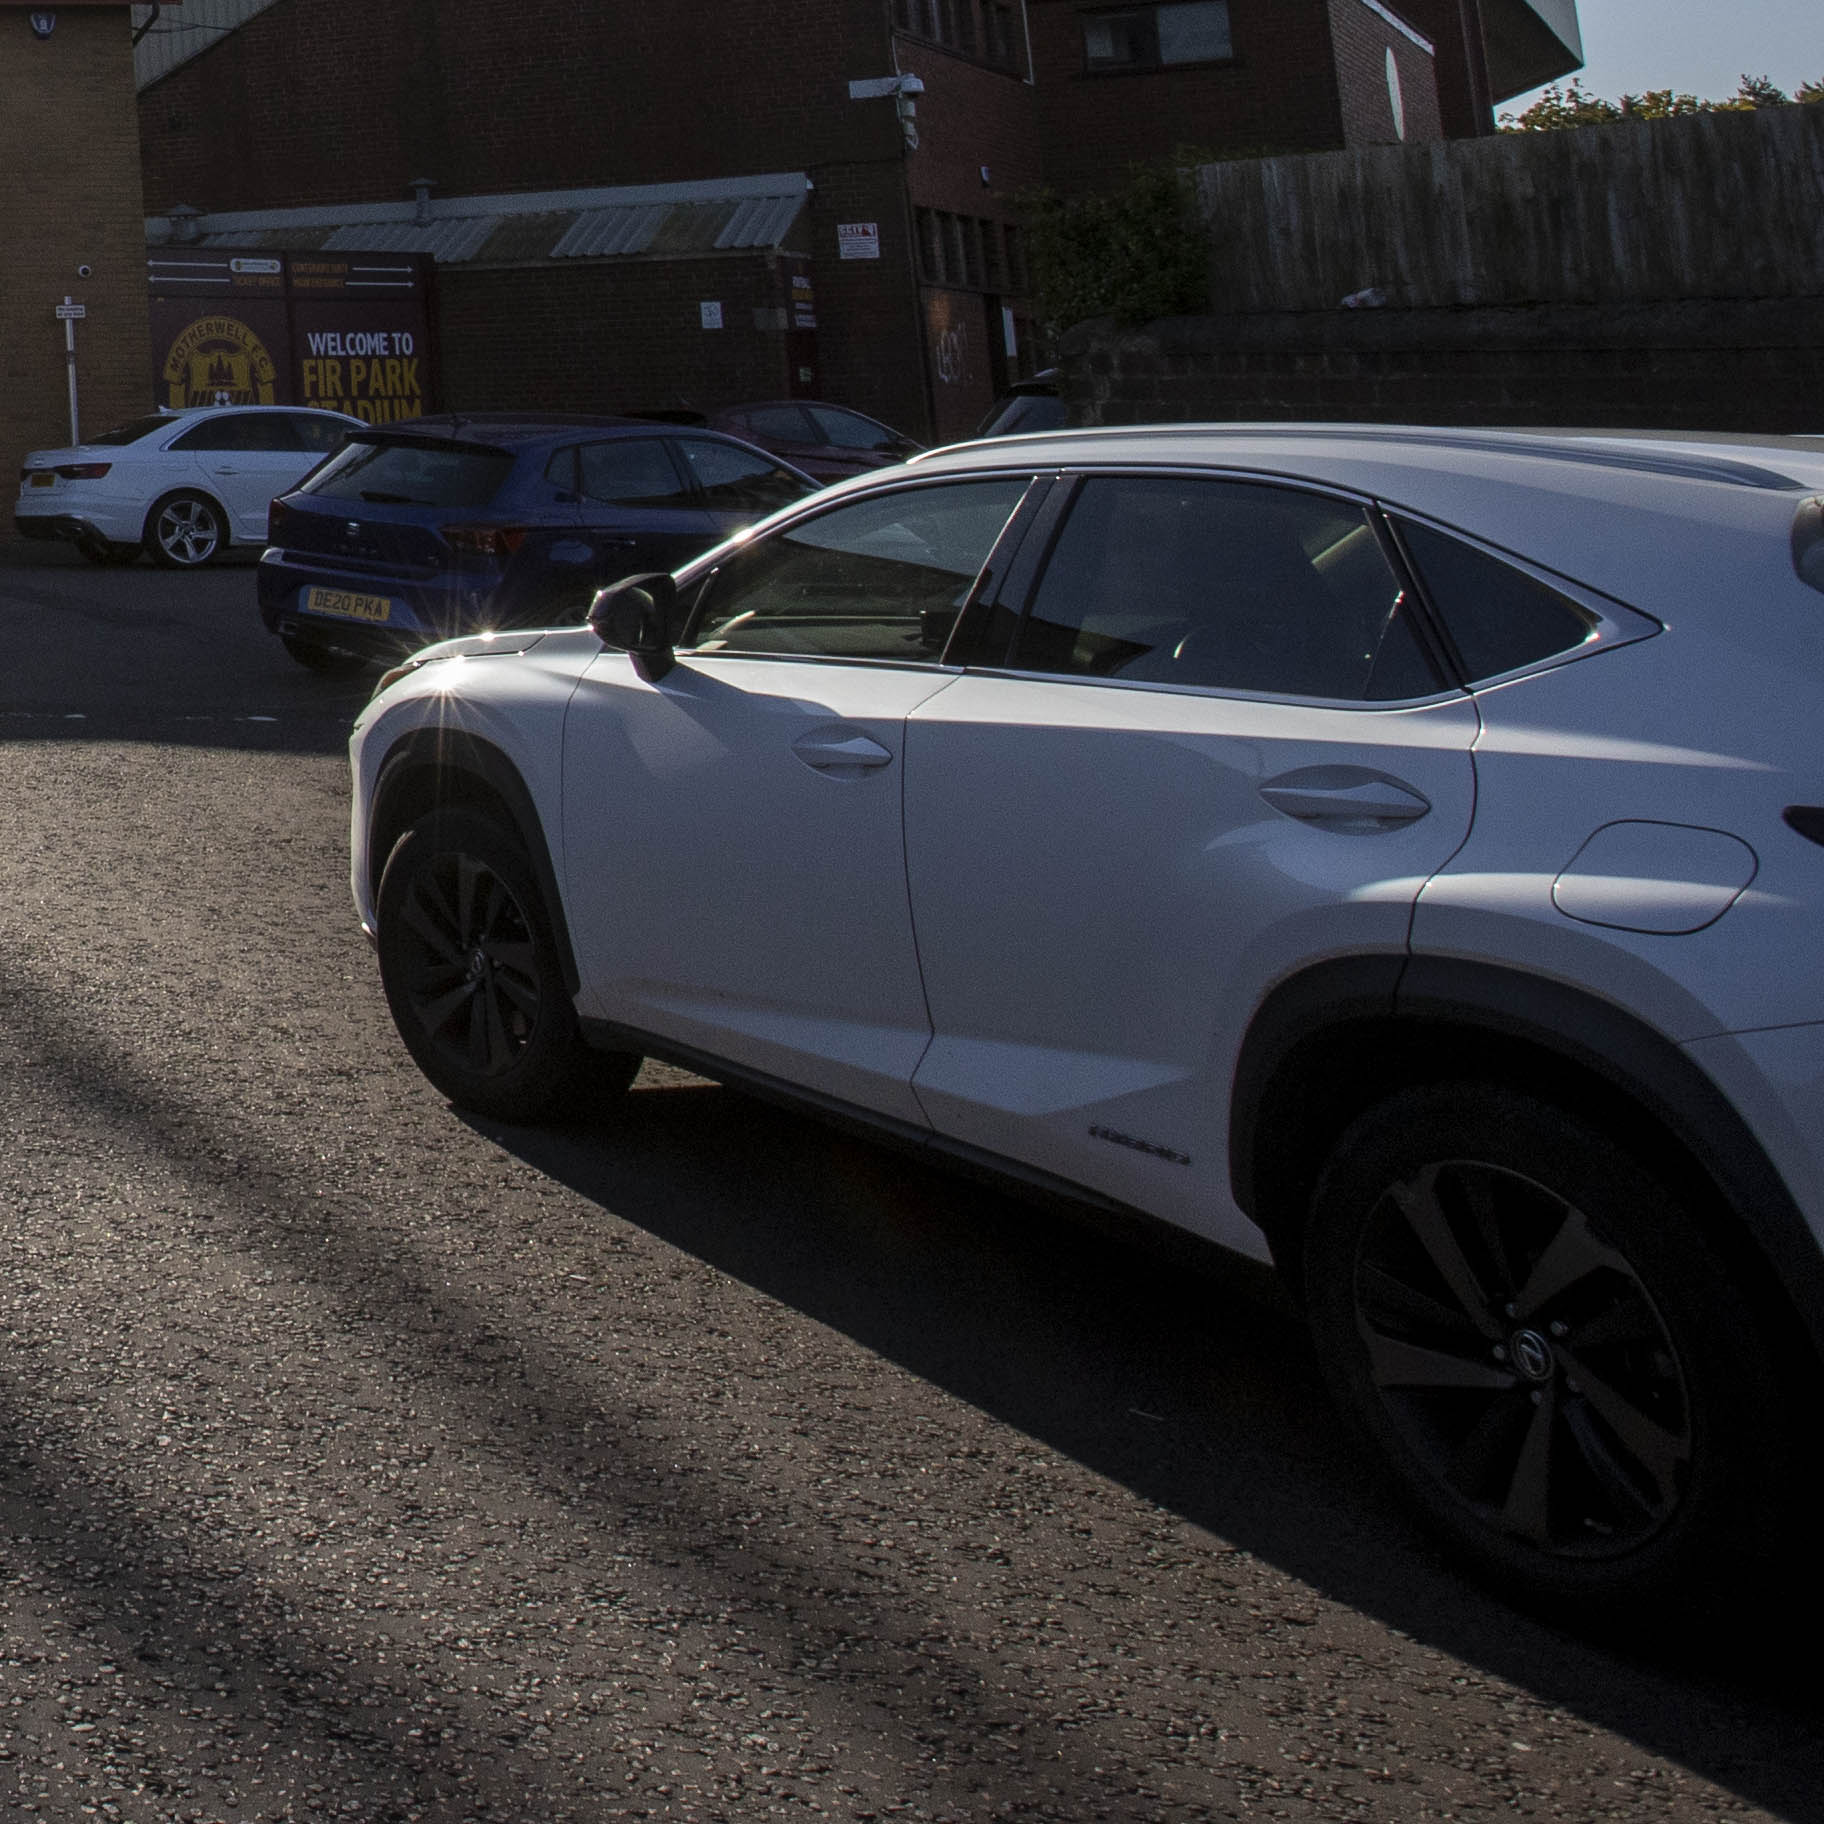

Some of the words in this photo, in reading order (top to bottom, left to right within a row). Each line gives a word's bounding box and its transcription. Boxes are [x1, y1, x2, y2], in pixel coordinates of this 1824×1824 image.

[170, 322, 248, 372] MOTHERWELL
[308, 332, 388, 356] WELCOME
[391, 332, 413, 355] TO
[303, 358, 344, 397] FIR
[350, 358, 422, 396] PARK
[314, 591, 350, 611] DE20
[354, 598, 382, 616] PKA
